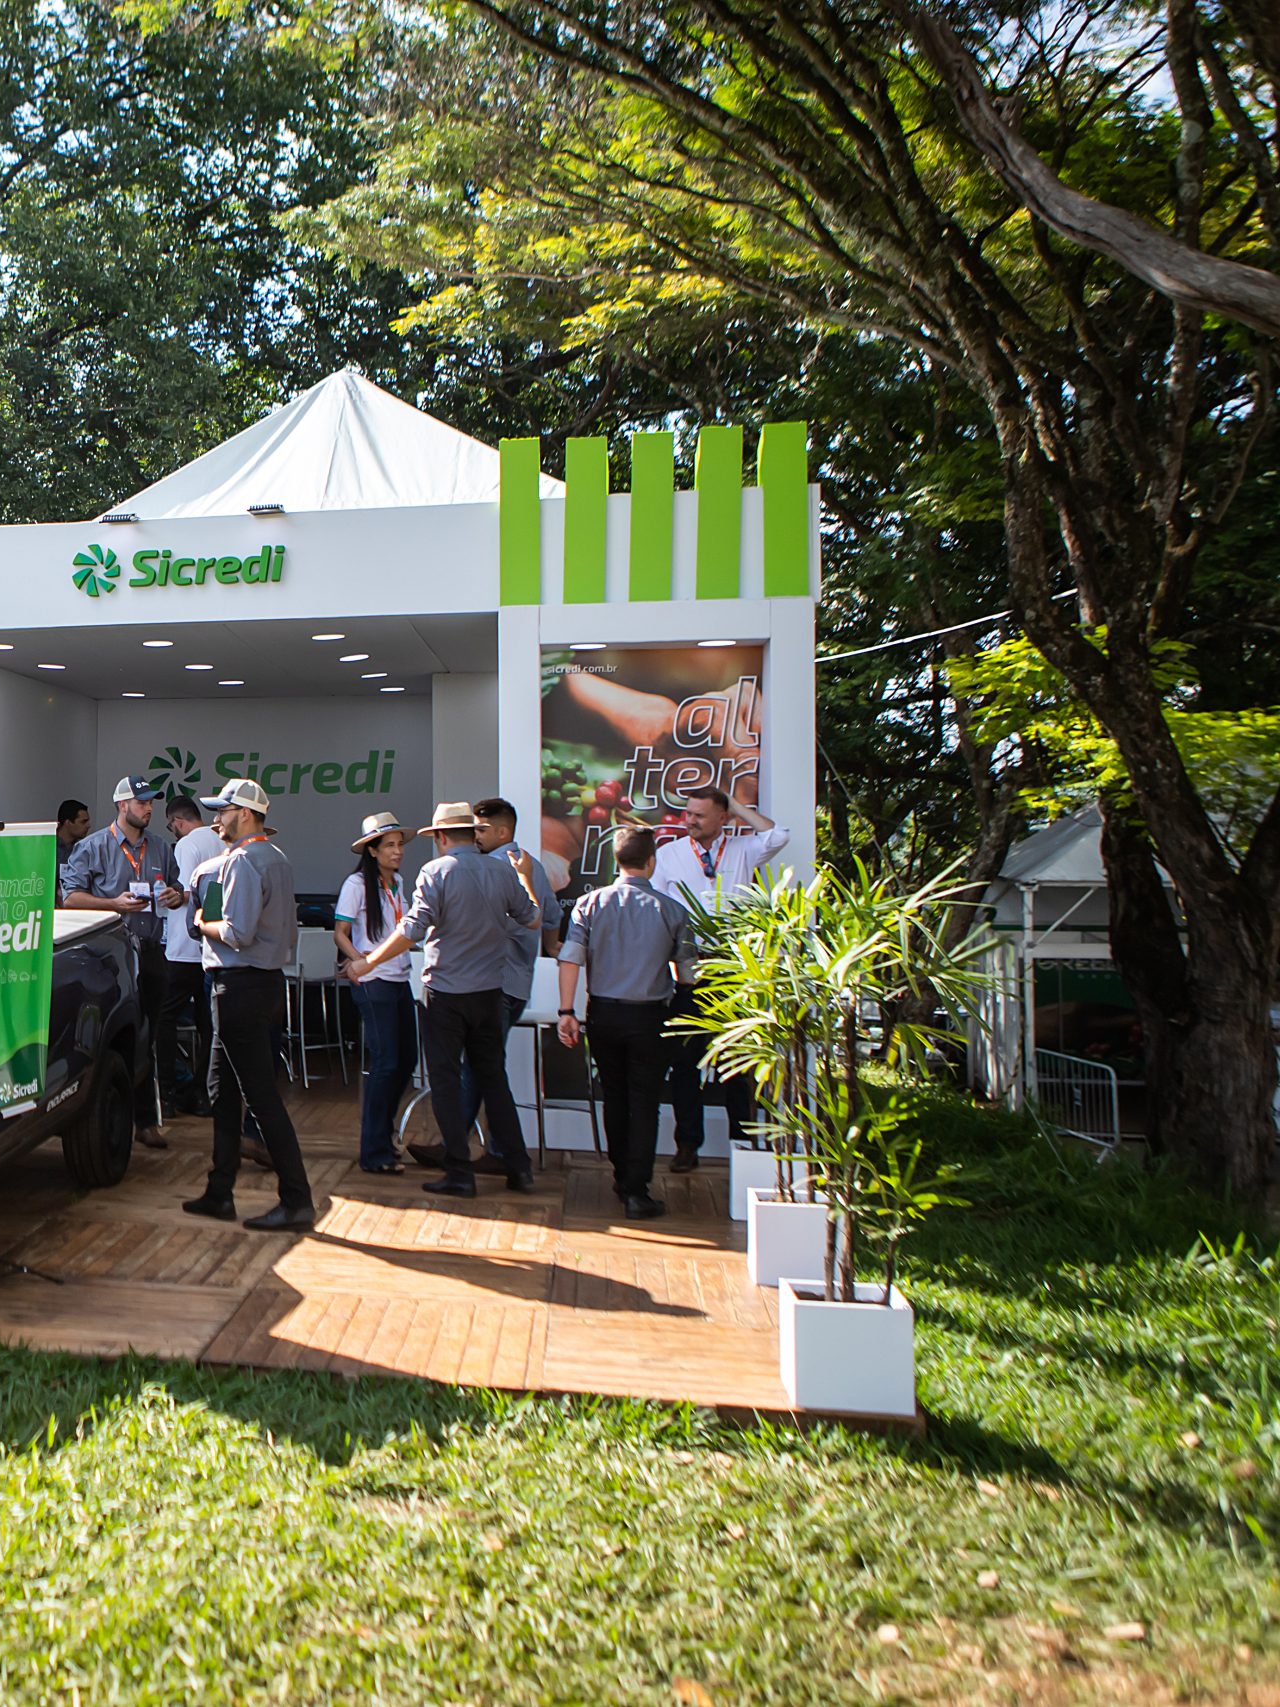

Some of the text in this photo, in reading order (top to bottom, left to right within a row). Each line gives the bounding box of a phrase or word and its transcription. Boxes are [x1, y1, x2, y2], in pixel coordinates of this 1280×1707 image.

[129, 545, 286, 588] Sicredi
[546, 664, 618, 674] sicredi.com.br
[673, 676, 759, 748] al
[212, 750, 396, 795] Sicredi
[624, 746, 760, 810] ter
[13, 1078, 38, 1100] Sicredi
